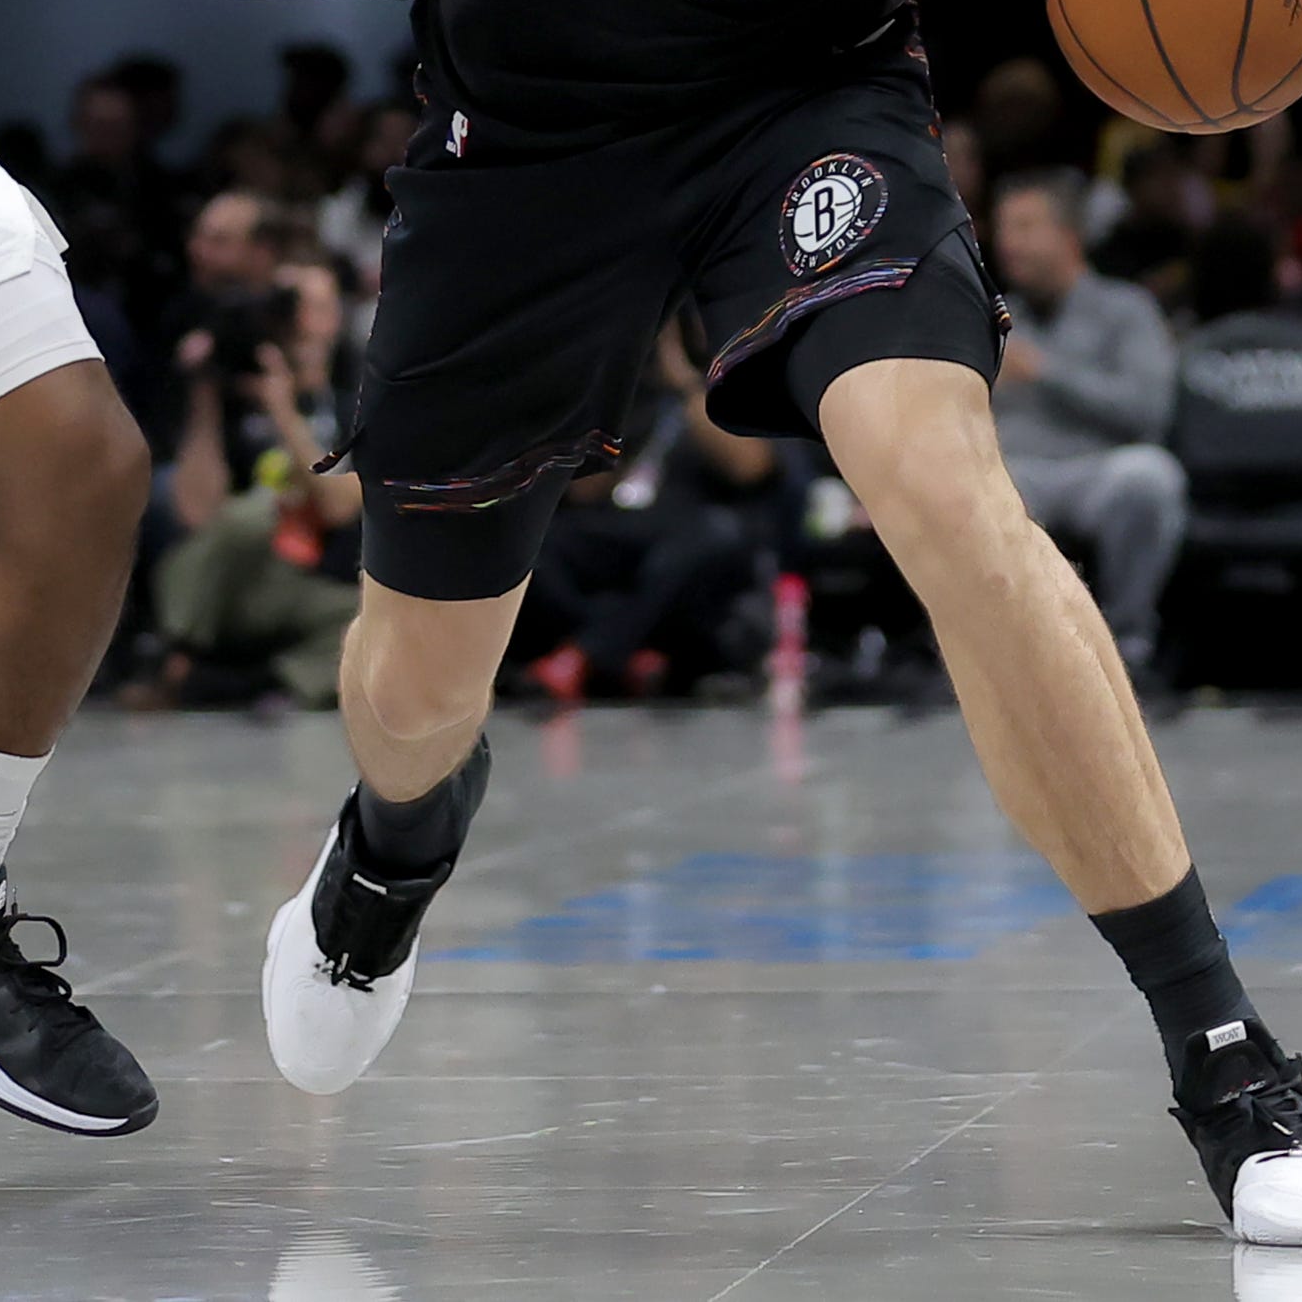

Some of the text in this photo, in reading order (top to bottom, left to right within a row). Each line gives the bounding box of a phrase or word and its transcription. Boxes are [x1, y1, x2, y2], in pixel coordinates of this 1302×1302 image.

[785, 161, 875, 218] BROOKLYN
[814, 186, 835, 242] B
[794, 217, 868, 268] NEW YORK
